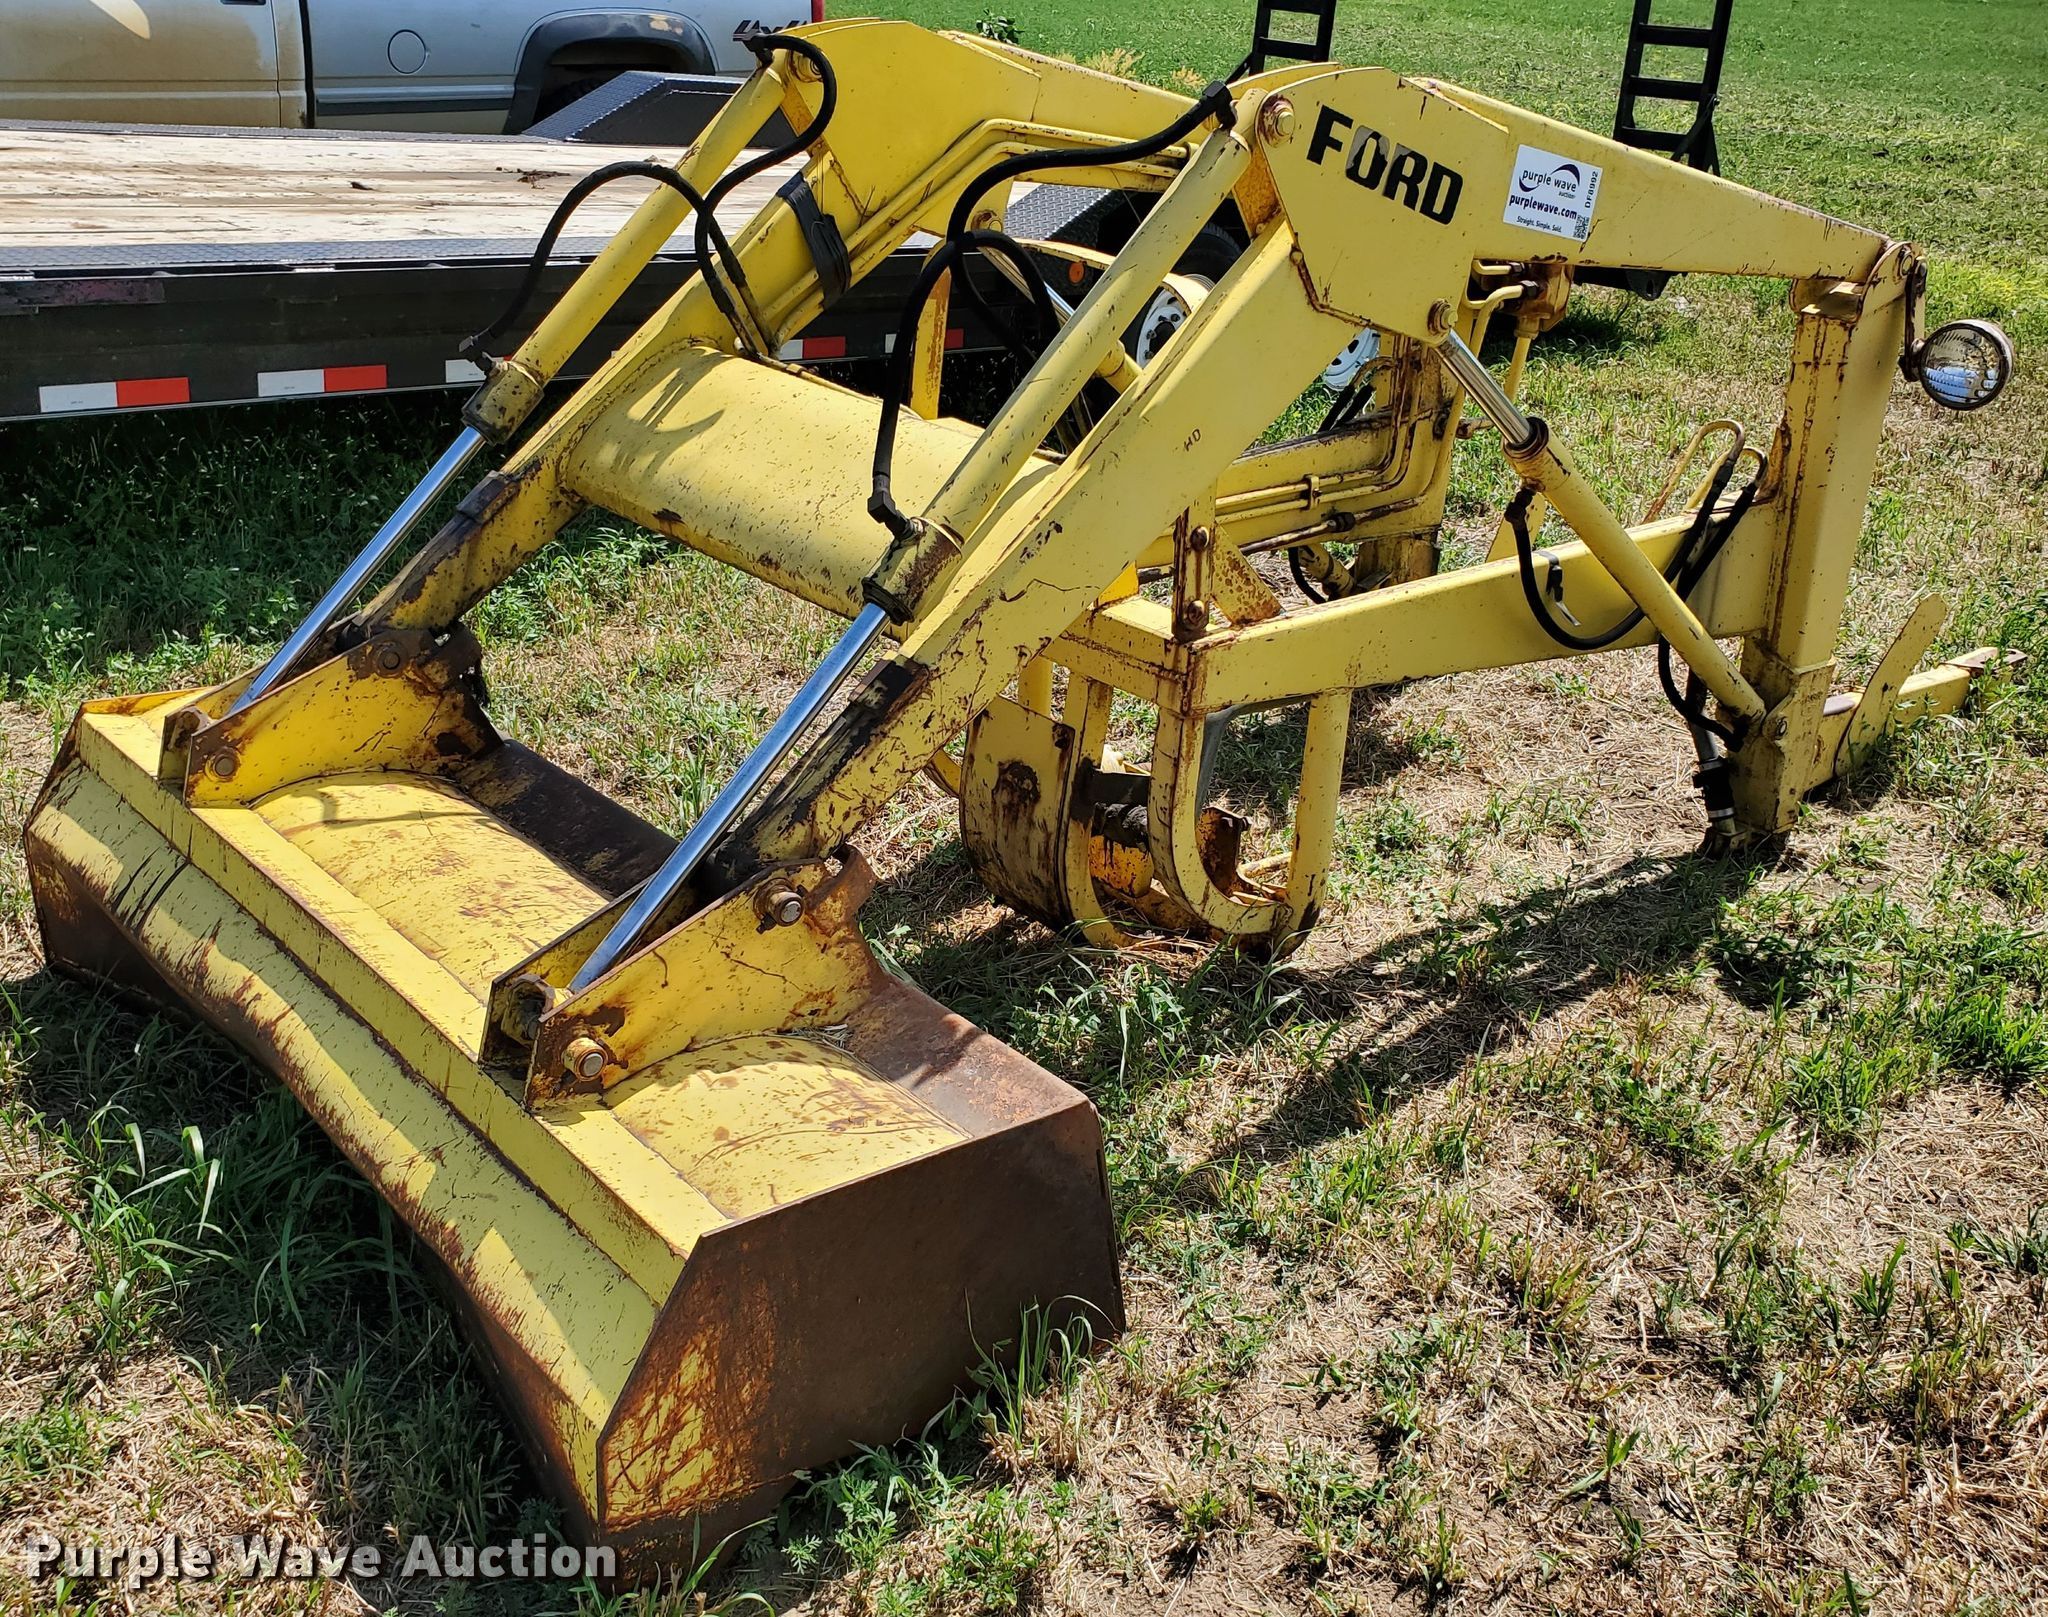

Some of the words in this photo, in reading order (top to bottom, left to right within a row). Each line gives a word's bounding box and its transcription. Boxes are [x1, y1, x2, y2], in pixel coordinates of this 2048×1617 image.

[1306, 104, 1464, 225] FORD
[1522, 170, 1551, 186] purple
[1554, 178, 1577, 192] wave
[1509, 194, 1577, 220] purplewave.com
